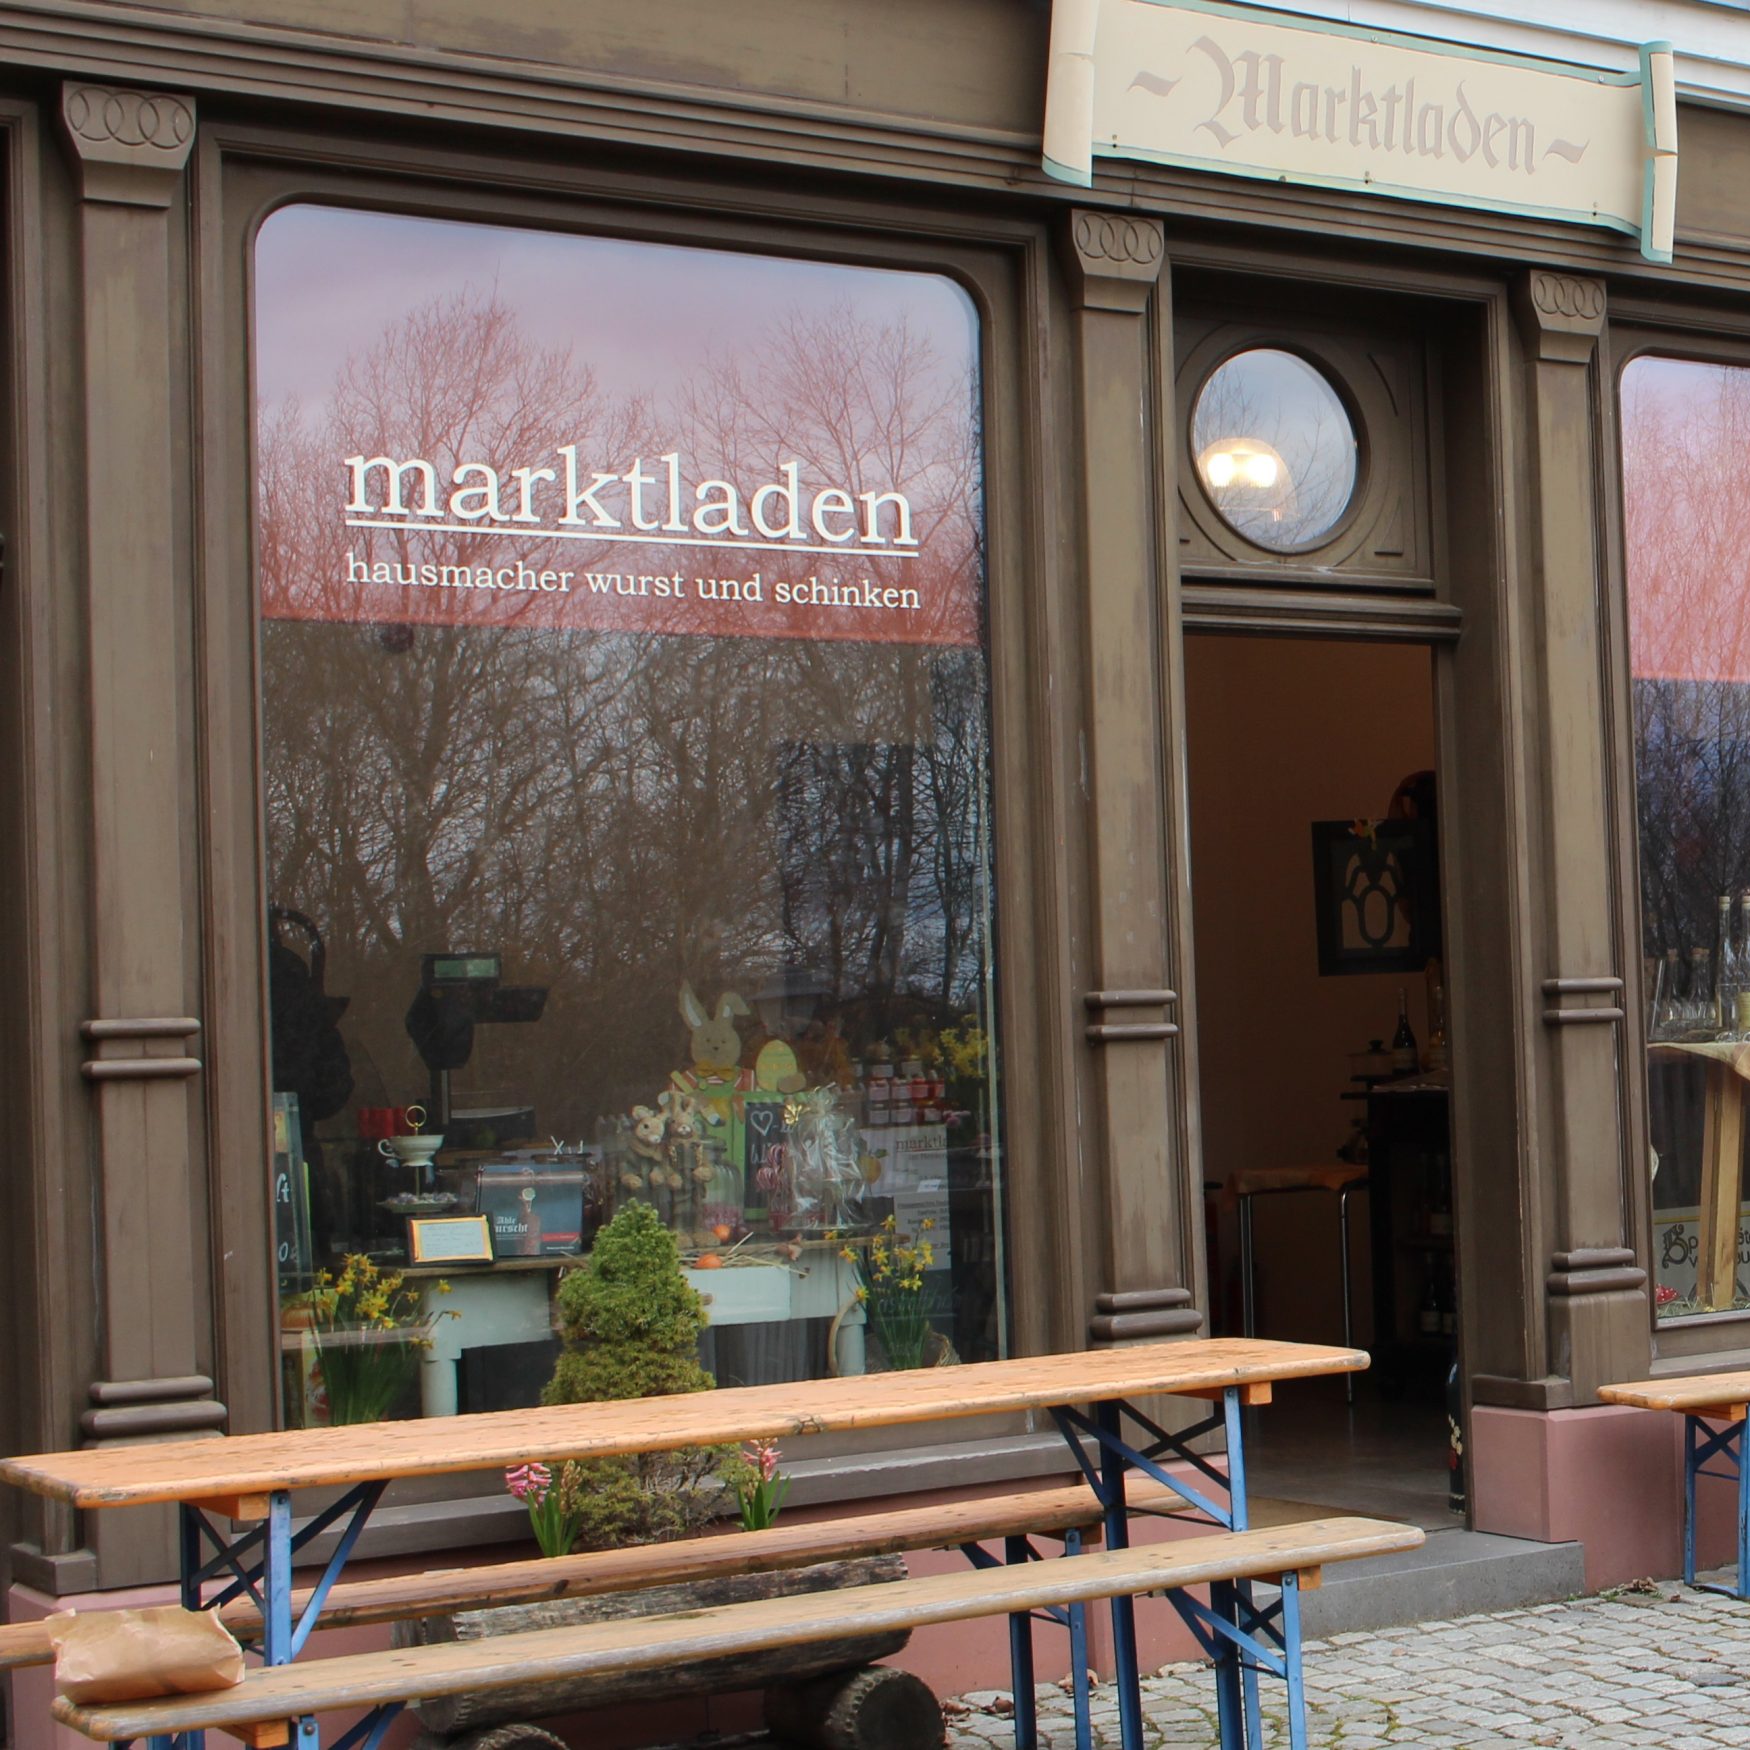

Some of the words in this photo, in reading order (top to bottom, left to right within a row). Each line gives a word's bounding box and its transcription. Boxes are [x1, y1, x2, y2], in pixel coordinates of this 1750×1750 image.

[1186, 35, 1536, 174] Marktladen
[344, 445, 919, 546] marktladen
[345, 553, 574, 593] hausmacher
[585, 569, 684, 598] wurst
[695, 573, 764, 602] und
[774, 577, 921, 610] schinken
